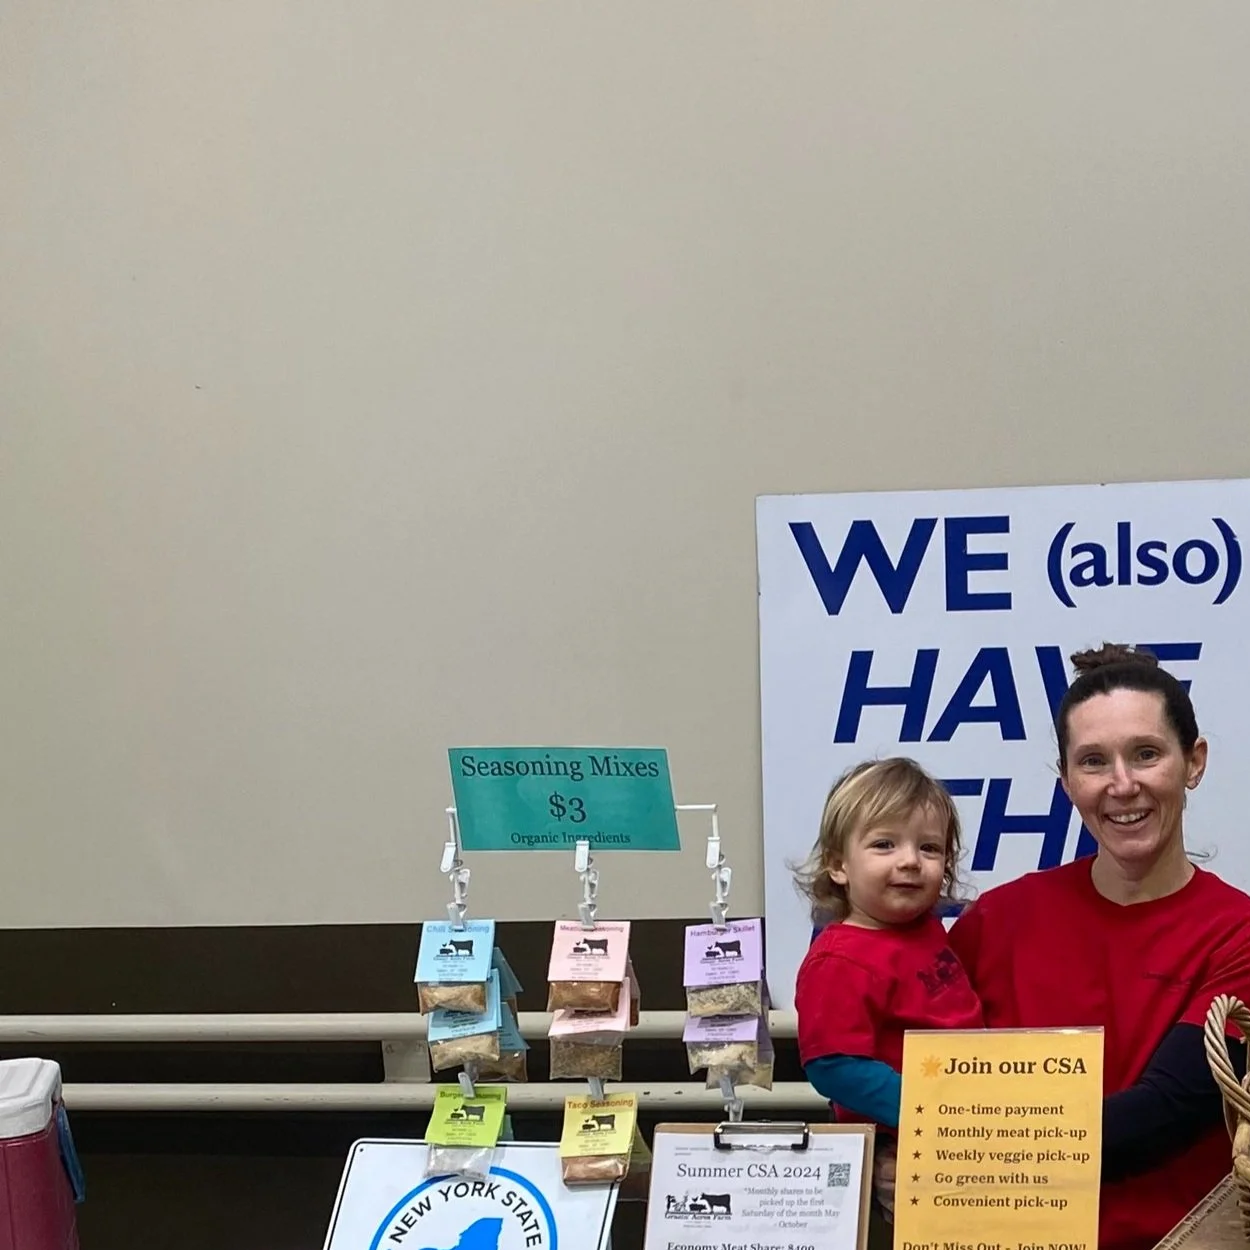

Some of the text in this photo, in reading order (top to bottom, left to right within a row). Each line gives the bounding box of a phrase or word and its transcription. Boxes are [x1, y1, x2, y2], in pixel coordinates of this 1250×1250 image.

[788, 515, 1242, 616] WE (also)
[833, 642, 1202, 743] HA
[462, 756, 659, 781] Seasoning Mixes
[549, 791, 587, 823] $3
[510, 832, 630, 846] Organic Ingredients
[733, 925, 755, 934] Skillet
[944, 1057, 1087, 1077] Join our CSA
[568, 1099, 634, 1109] Taco Seasoning
[938, 1104, 1064, 1117] One-time payment
[937, 1126, 1087, 1141] Monthly meat pick-up
[935, 1149, 1091, 1164] Weekly veggie pick-up
[677, 1163, 821, 1180] Summer CSA 2024
[934, 1172, 1049, 1186] Go green with us
[933, 1196, 1068, 1210] Convenient pick-up
[389, 1181, 542, 1249] NEW YORK STATE
[778, 1221, 807, 1229] October
